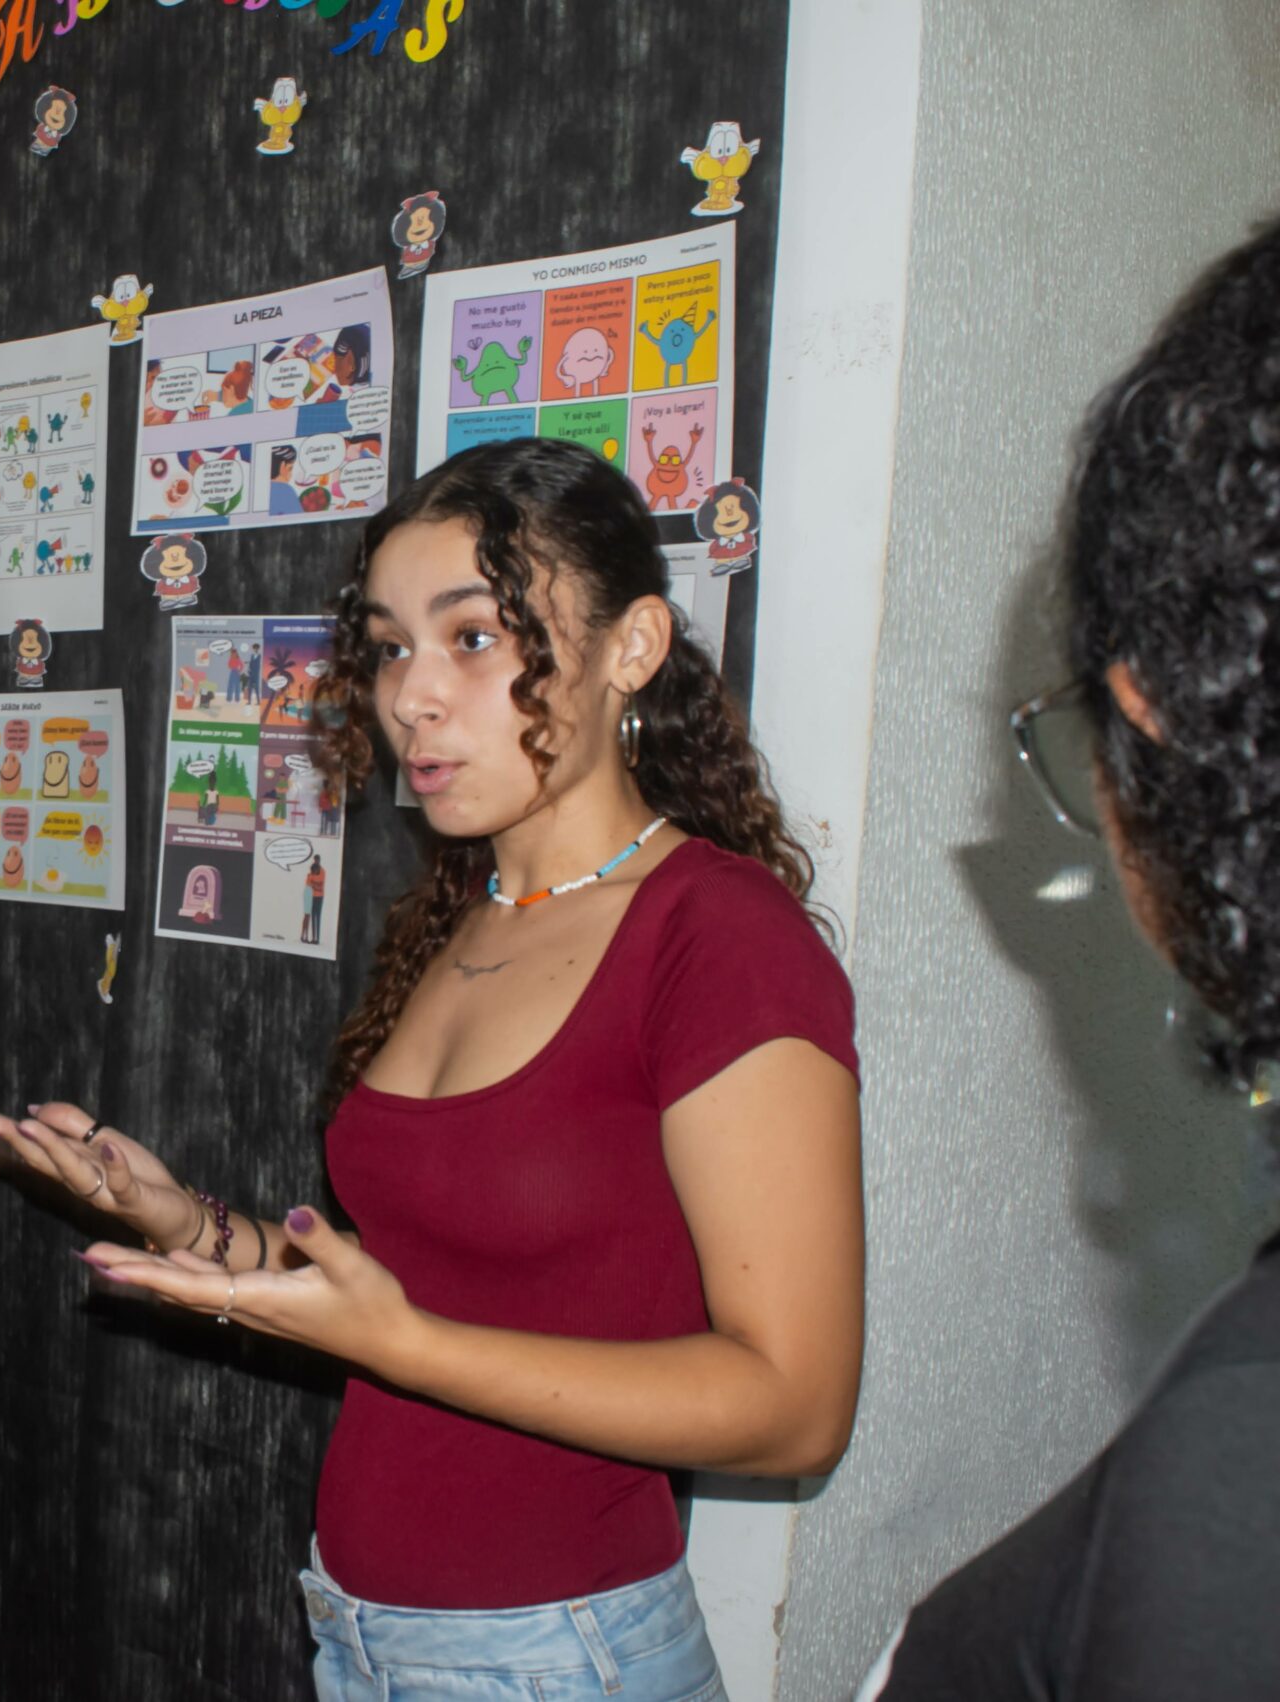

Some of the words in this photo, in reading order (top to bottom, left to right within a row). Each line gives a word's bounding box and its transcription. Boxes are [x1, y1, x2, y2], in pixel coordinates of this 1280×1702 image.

[532, 269, 548, 281] YO
[551, 261, 606, 279] CONMIGO
[608, 254, 648, 270] MISMO
[648, 280, 666, 291] Pero
[668, 277, 685, 289] poco
[694, 272, 712, 284] poco
[233, 312, 249, 325] LA
[251, 305, 284, 321] PIEZA
[469, 307, 482, 316] No
[484, 306, 497, 315] me
[472, 319, 503, 330] mucho
[505, 317, 523, 330] hoy
